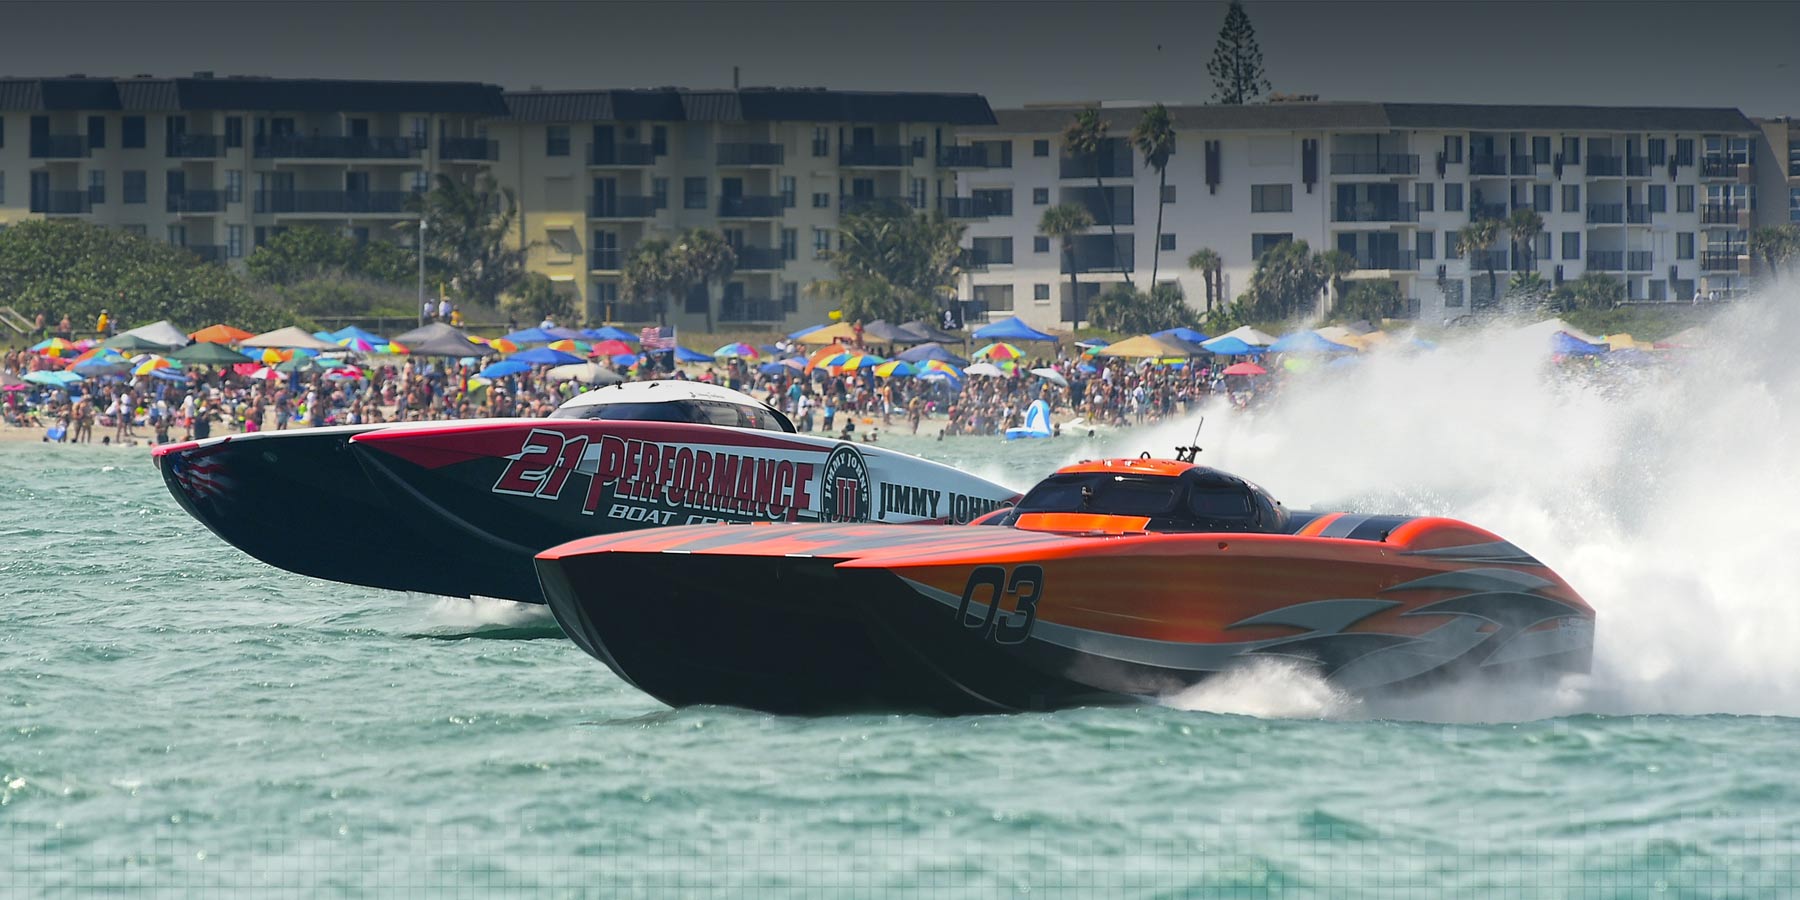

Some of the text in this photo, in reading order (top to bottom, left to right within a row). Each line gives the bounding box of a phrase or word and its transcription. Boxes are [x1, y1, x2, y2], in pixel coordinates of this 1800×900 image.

[492, 428, 819, 522] 21 PERFORMANCE
[825, 453, 845, 499] JIMMY
[608, 504, 677, 525] BOAT
[878, 482, 941, 520] JIMMY
[955, 563, 1043, 645] 03
